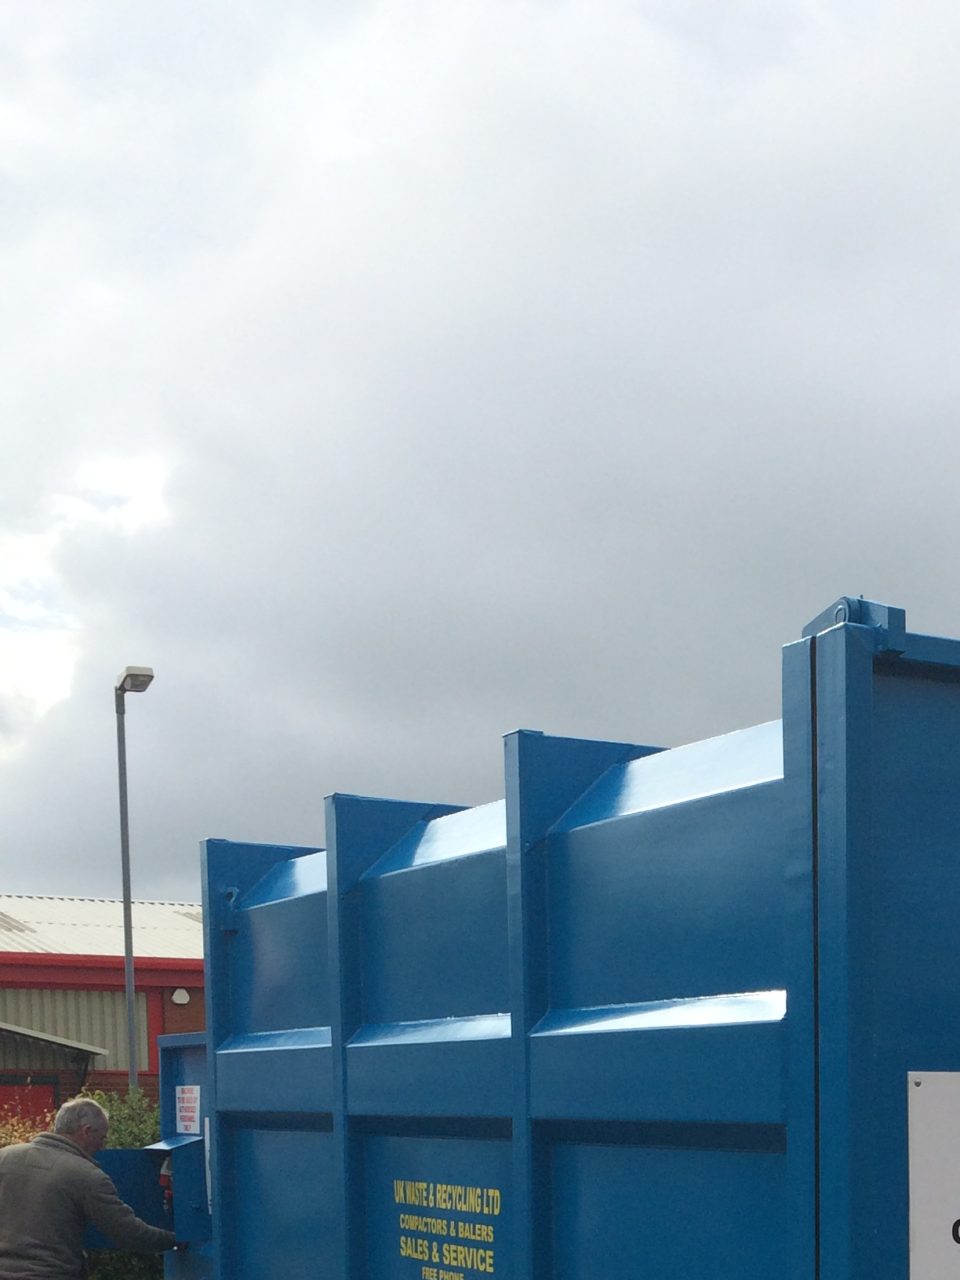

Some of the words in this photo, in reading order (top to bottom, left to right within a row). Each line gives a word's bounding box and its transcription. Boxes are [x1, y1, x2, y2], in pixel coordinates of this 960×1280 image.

[393, 1179, 405, 1204] UK
[405, 1181, 428, 1207] WASTE
[429, 1182, 435, 1208] &
[436, 1184, 482, 1214] RECYCLING
[483, 1189, 501, 1216] LTD
[400, 1214, 448, 1236] COMPACTORS
[449, 1221, 456, 1237] &
[458, 1222, 494, 1242] BALERS
[400, 1236, 429, 1261] SALES
[432, 1242, 440, 1263] &
[442, 1243, 495, 1273] SERVICE
